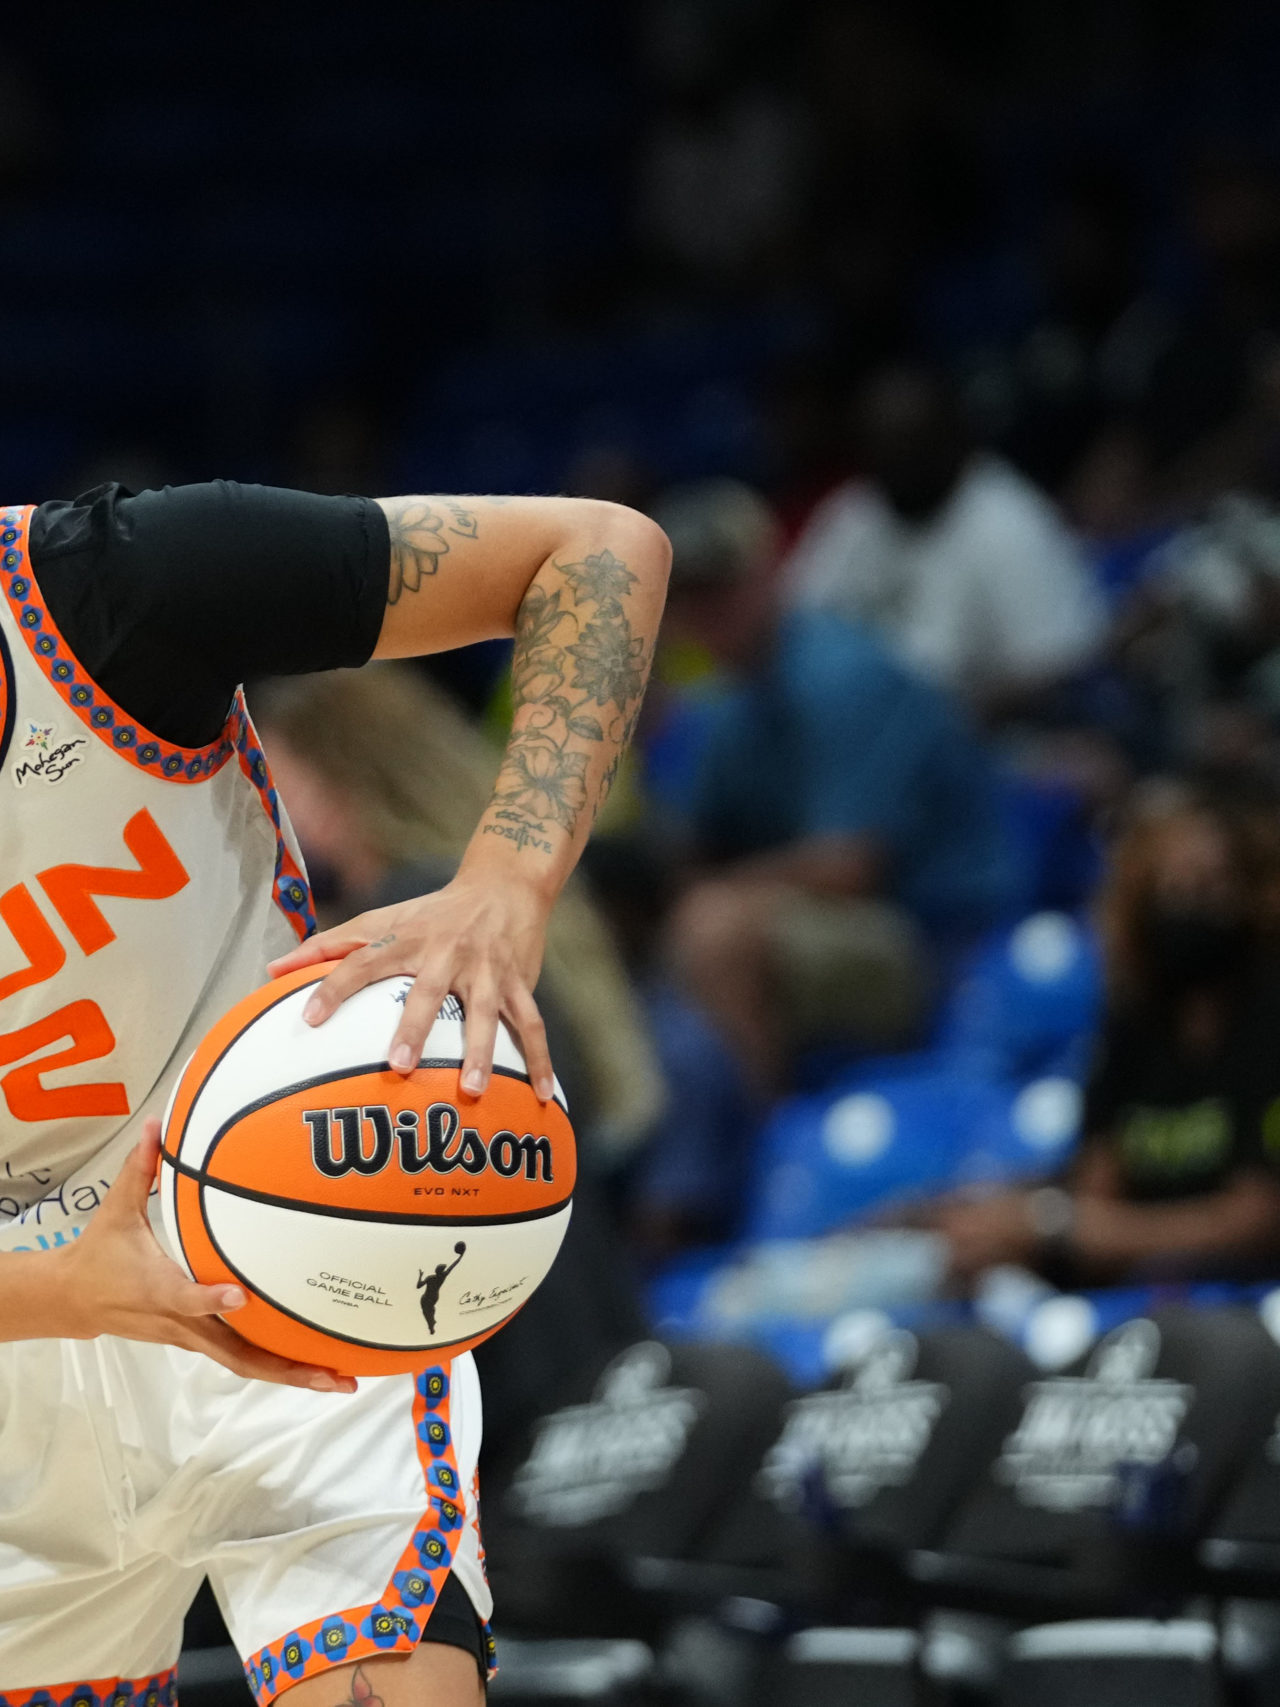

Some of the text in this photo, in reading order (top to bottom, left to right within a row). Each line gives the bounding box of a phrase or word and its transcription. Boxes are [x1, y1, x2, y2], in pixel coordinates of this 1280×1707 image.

[45, 758, 80, 782] Sun
[302, 1102, 554, 1183] Wilson
[414, 1187, 480, 1197] EVO NXT
[306, 1278, 393, 1307] GAME BALL
[319, 1271, 387, 1295] OFFICIAL
